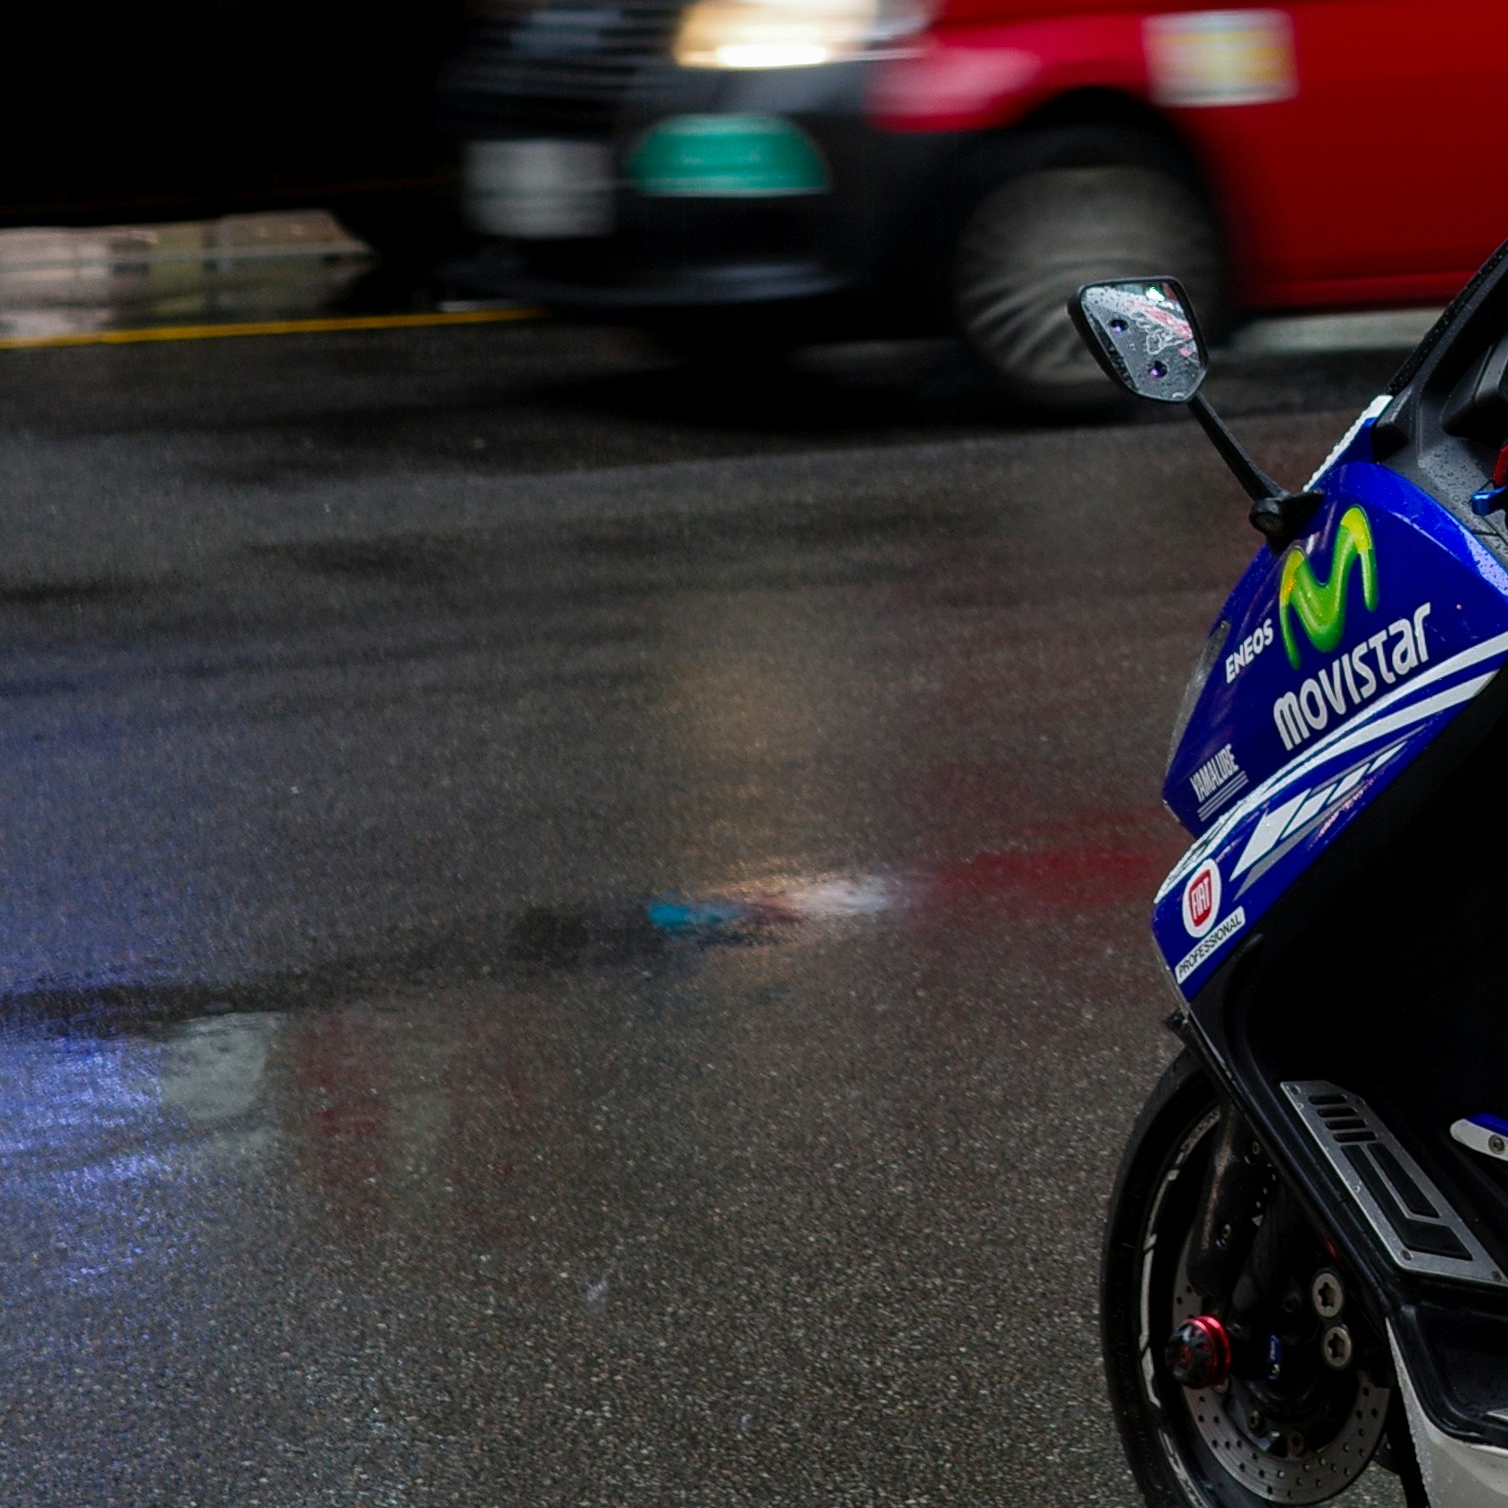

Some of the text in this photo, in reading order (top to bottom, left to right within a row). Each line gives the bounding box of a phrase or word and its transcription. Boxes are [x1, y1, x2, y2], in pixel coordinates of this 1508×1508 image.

[1225, 618, 1275, 684] ENEOS
[1273, 602, 1432, 752] movistar
[1189, 742, 1241, 804] YAMALUBE
[1190, 875, 1211, 921] FIAT
[1177, 913, 1243, 979] PROFESSIONAL
